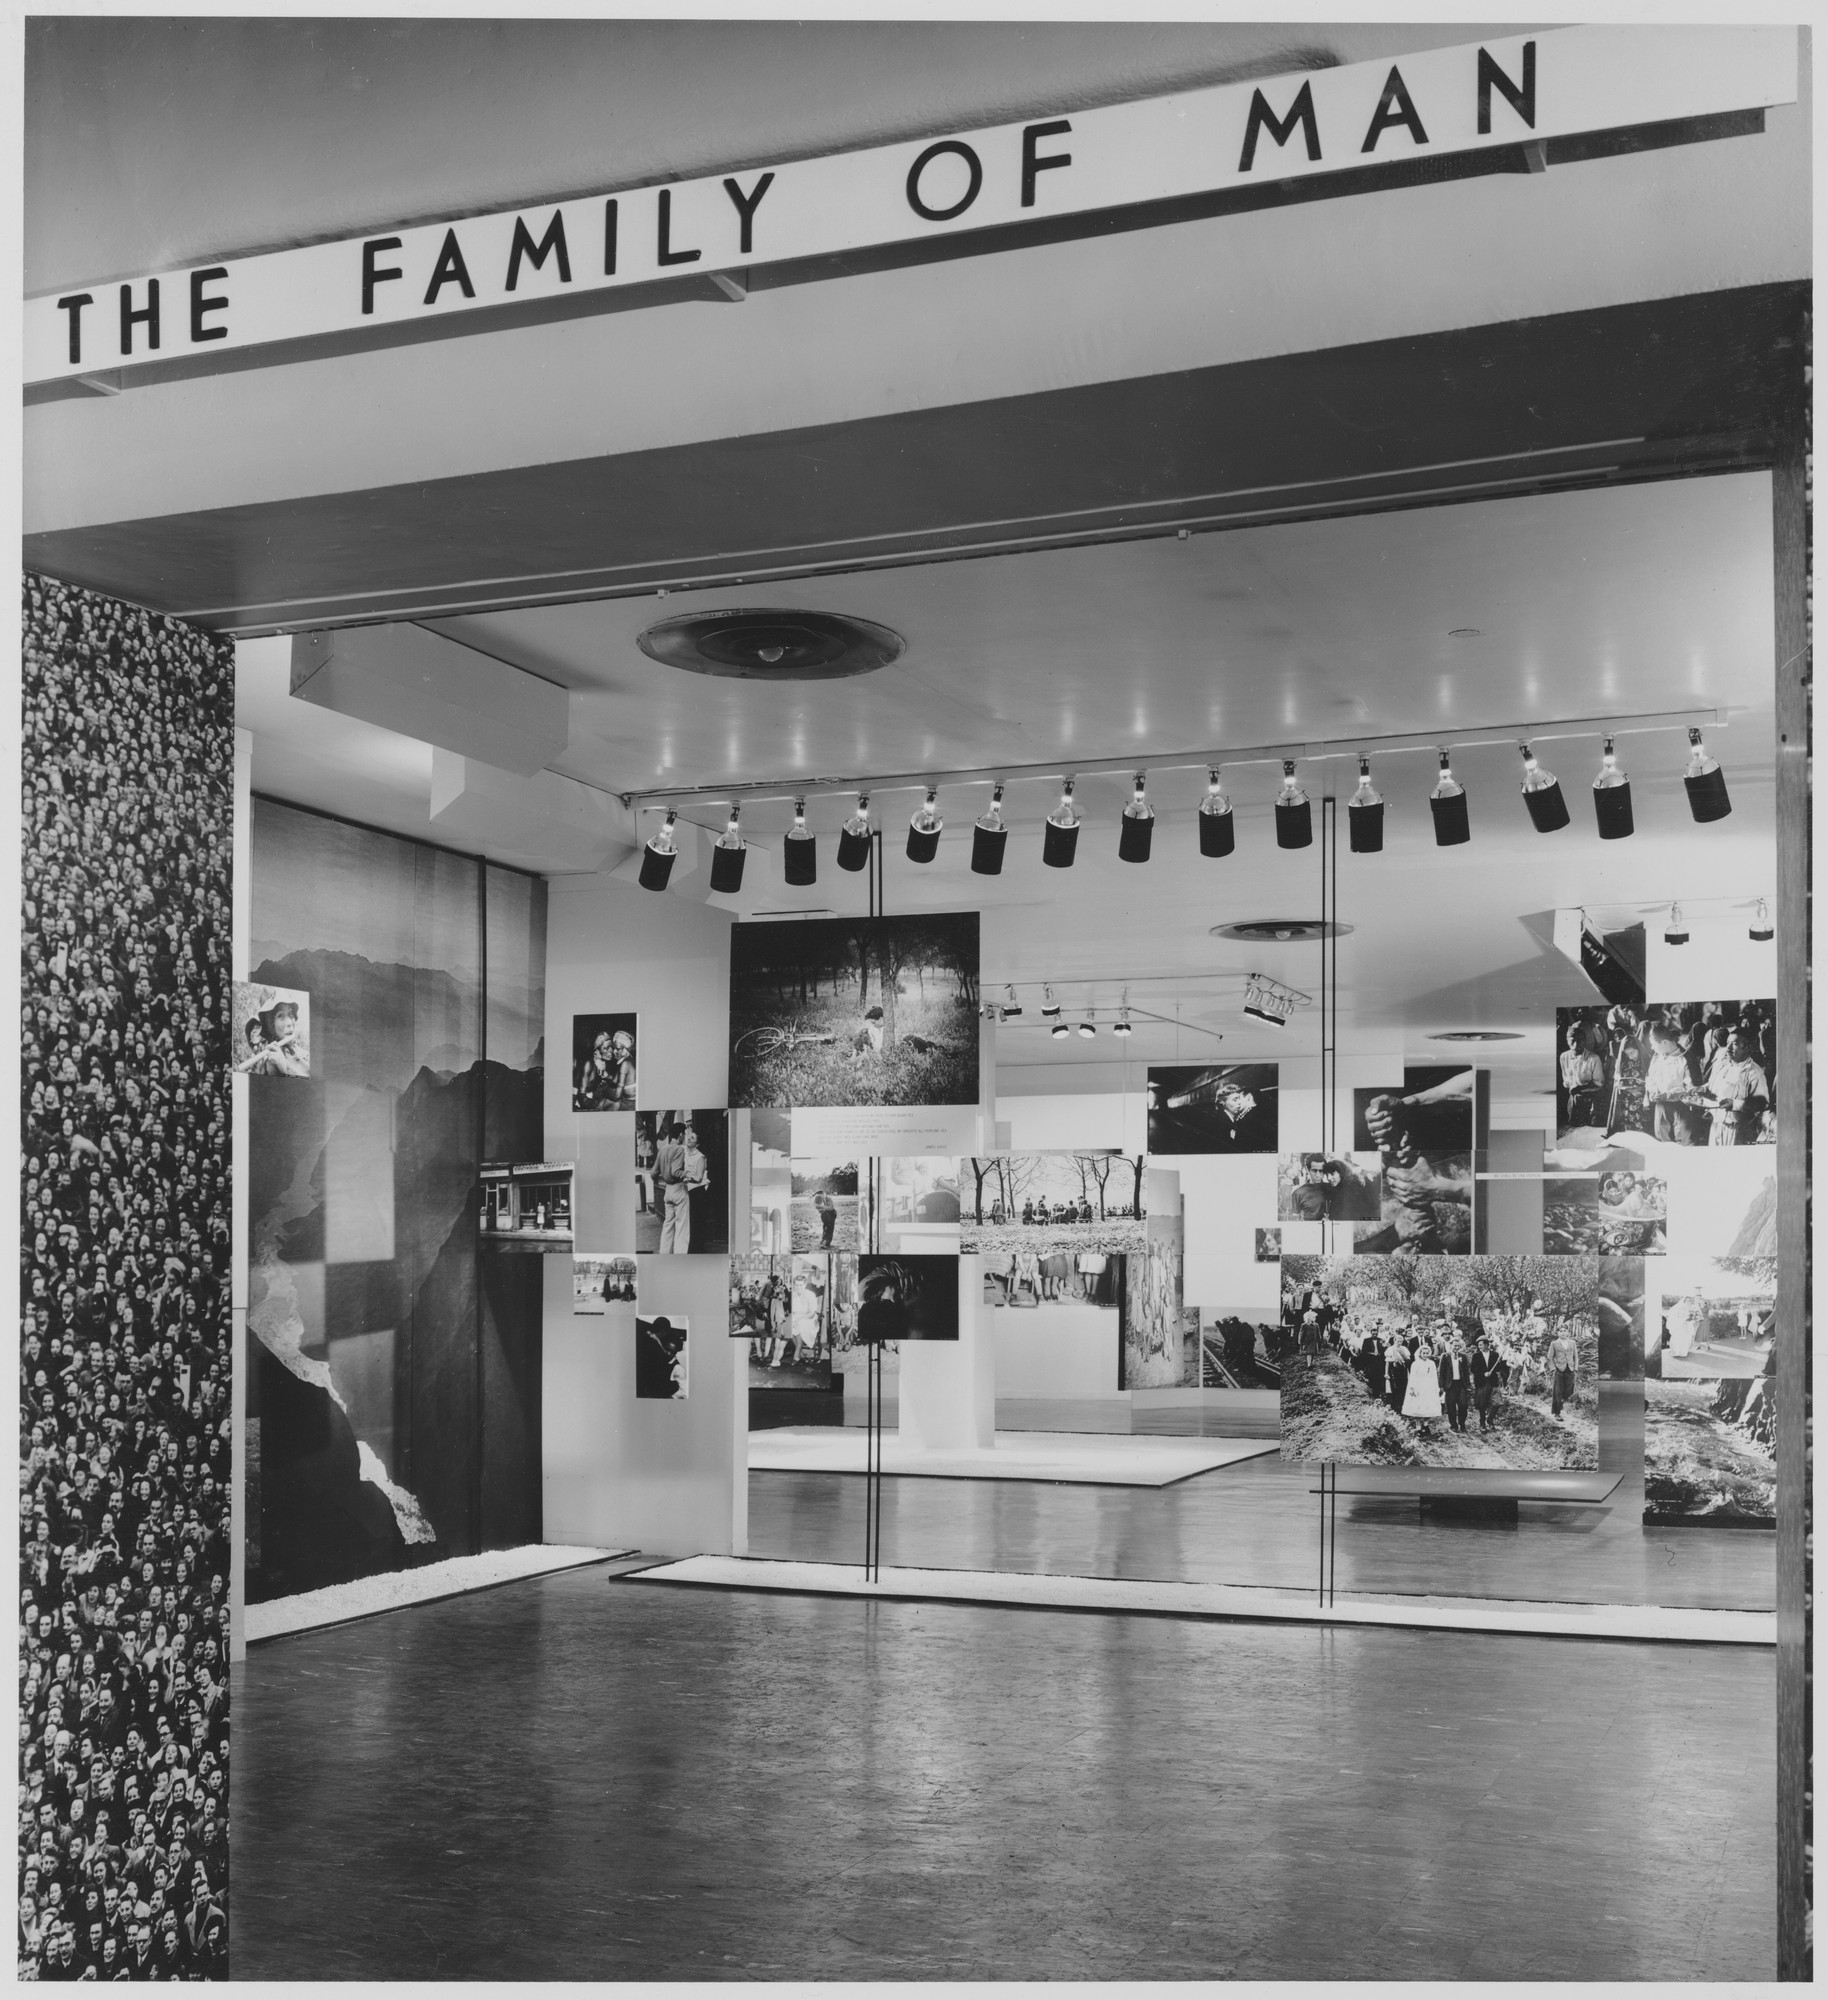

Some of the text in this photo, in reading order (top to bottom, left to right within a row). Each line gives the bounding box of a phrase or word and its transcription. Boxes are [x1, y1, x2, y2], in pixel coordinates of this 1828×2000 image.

[56, 40, 1537, 365] THE FAMILY OF MAN
